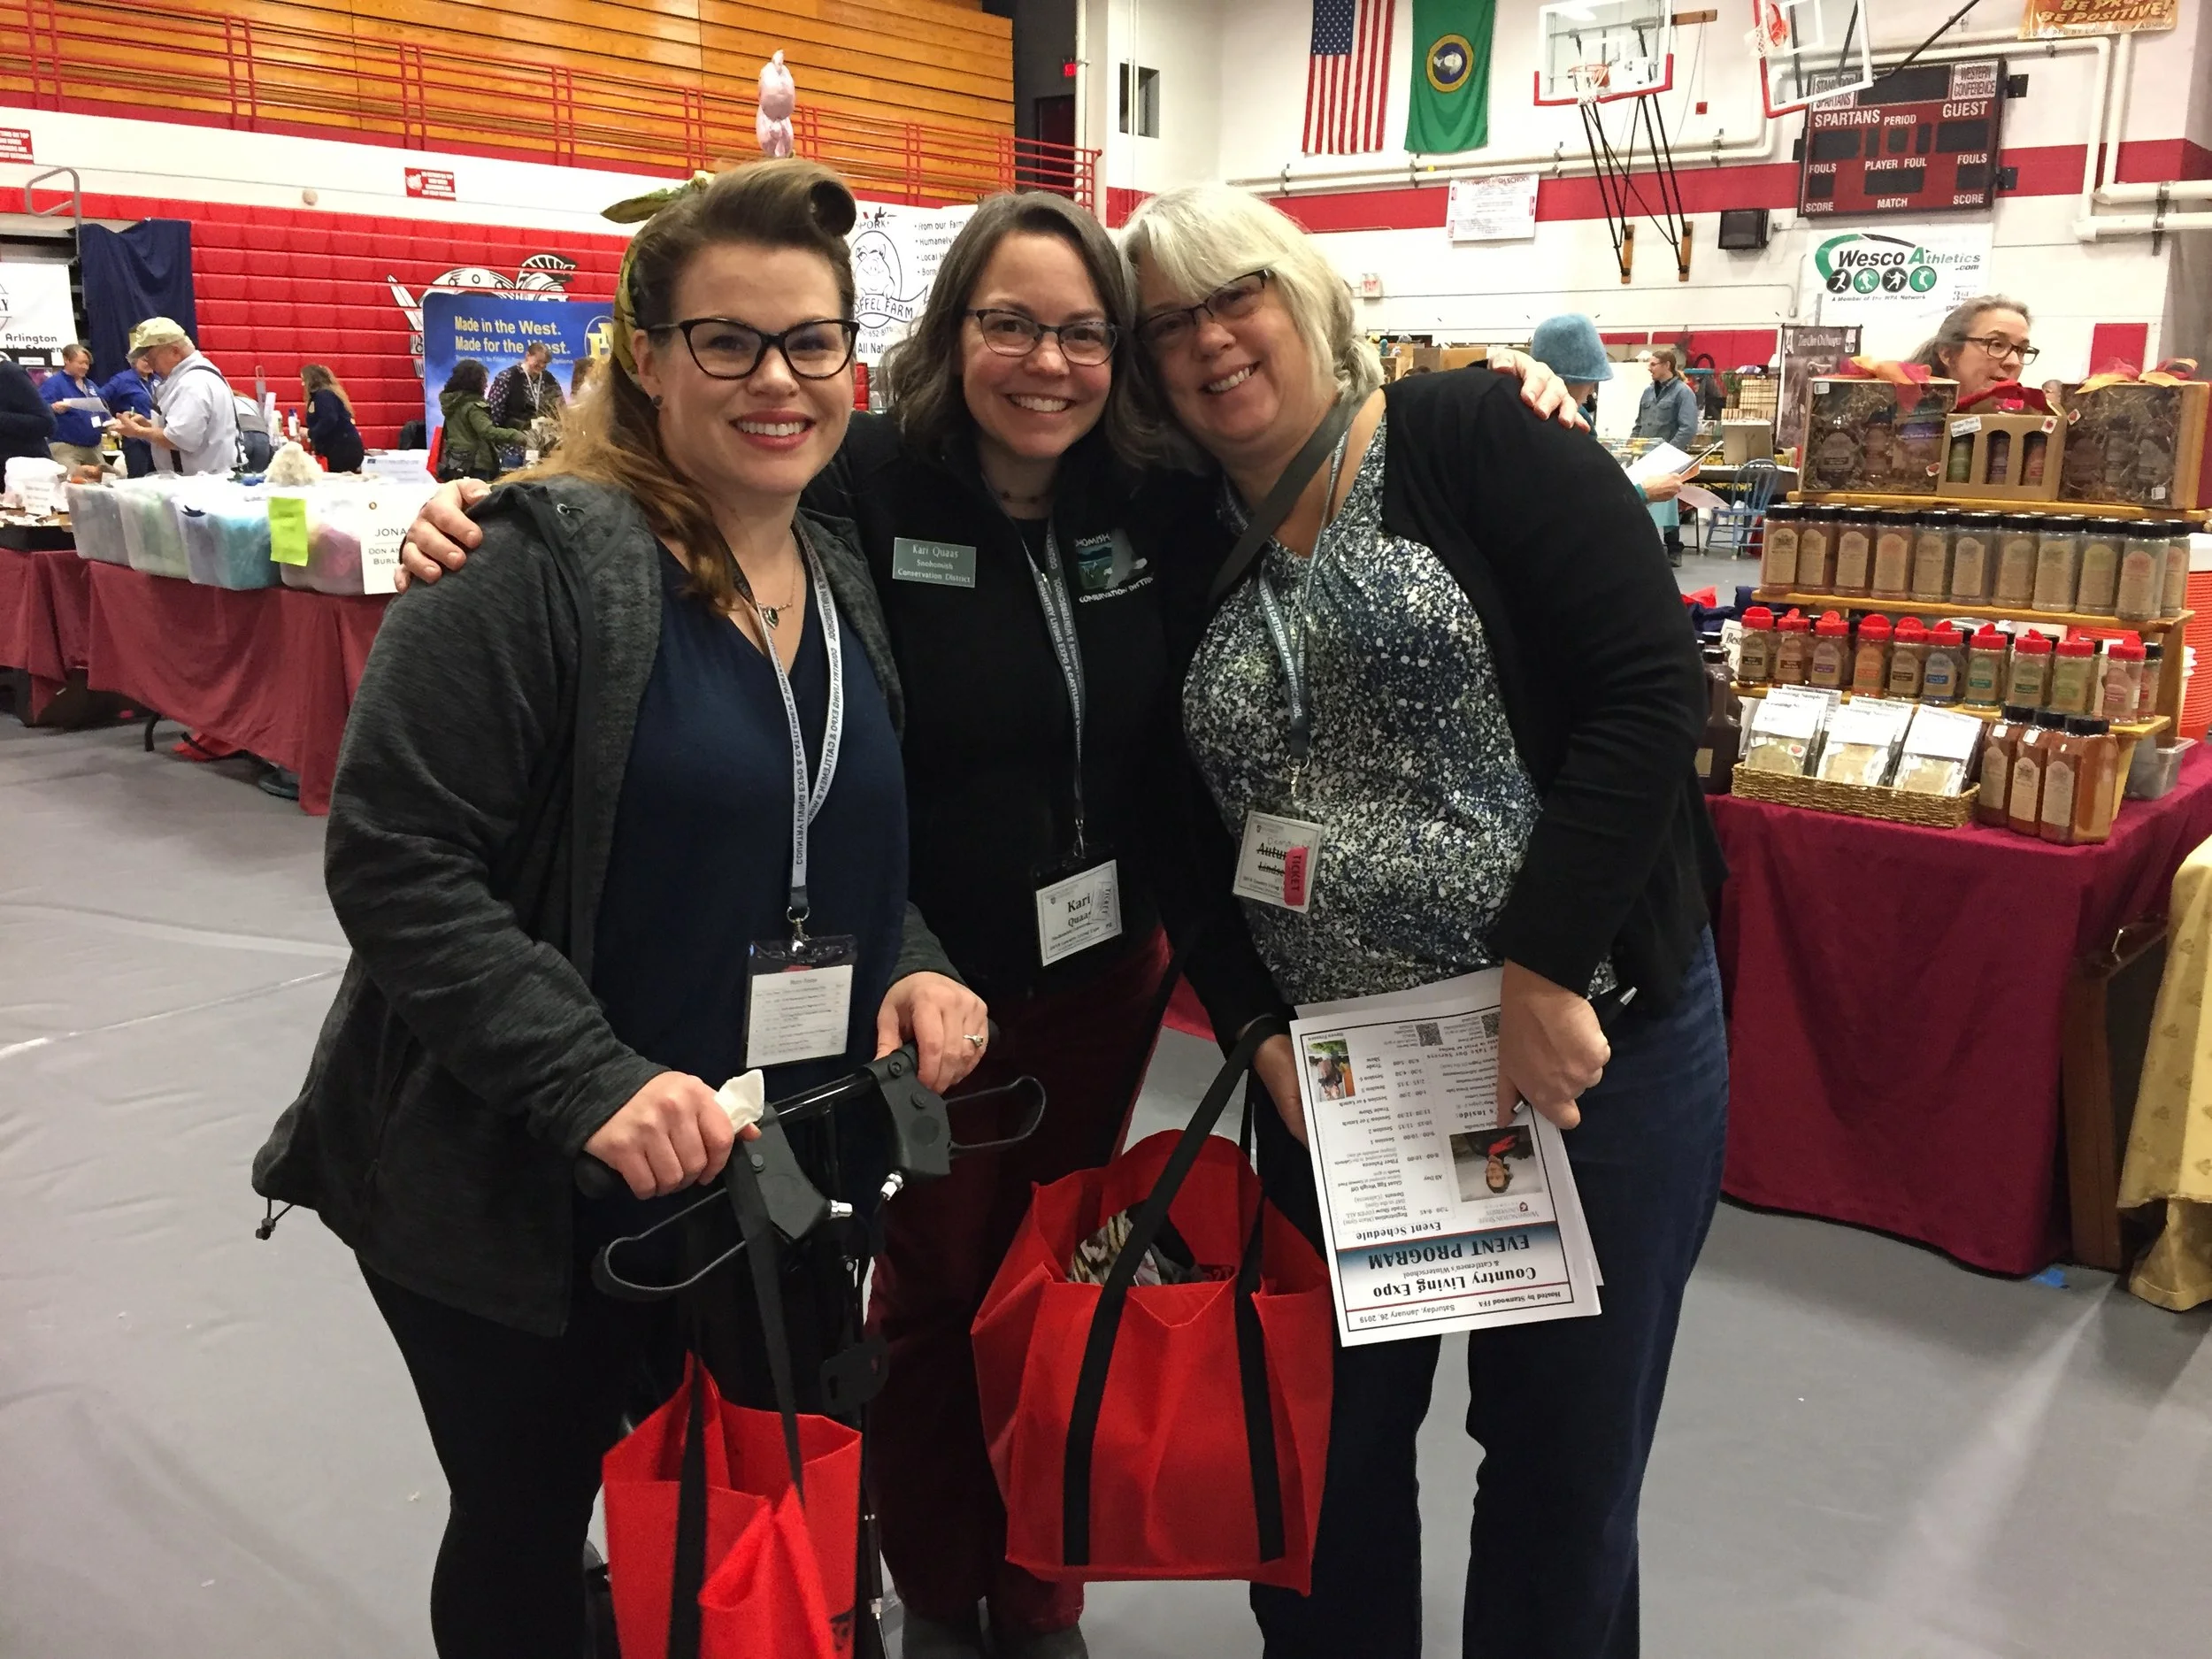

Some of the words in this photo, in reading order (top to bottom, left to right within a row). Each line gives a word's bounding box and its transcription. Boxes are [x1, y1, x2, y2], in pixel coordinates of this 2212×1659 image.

[2038, 12, 2067, 23] BE
[2070, 0, 2173, 22] POSITIVE!
[1943, 101, 1987, 118] GUEST
[1815, 110, 1880, 127] SPARTANS
[1884, 114, 1916, 126] PERIOD
[1865, 159, 1898, 170] PLAYER
[1904, 157, 1927, 168] FOUL
[1957, 154, 1987, 165] FOULS
[1809, 163, 1837, 173] FOULS
[1877, 198, 1908, 209] MATCH
[1954, 193, 1984, 204] SCORE
[1805, 202, 1833, 212] SCORE
[1838, 250, 1905, 267] Wesco
[1908, 246, 1981, 265] Athletics
[885, 301, 913, 319] FARM
[455, 315, 480, 333] Made
[481, 317, 492, 333] in
[495, 319, 516, 334] the
[518, 319, 562, 335] West.
[5, 333, 58, 344] Arlington
[455, 336, 481, 352] Made
[484, 336, 501, 352] for
[503, 338, 525, 353] the
[858, 342, 868, 354] All
[912, 544, 929, 555] Kari
[897, 568, 942, 580] Conservation
[1291, 855, 1302, 892] TICKET
[1067, 893, 1091, 913] Kari
[1355, 1225, 1406, 1241] Schedule
[1409, 1221, 1440, 1233] Event
[1468, 1233, 1530, 1256] EVENT
[1367, 1241, 1462, 1270] PROGRAM
[1402, 1266, 1450, 1279] Winterschool
[1449, 1260, 1493, 1272] Cattlemen's
[1470, 1263, 1537, 1286] Country
[1415, 1272, 1465, 1294] Living
[1371, 1280, 1410, 1300] Expo
[1536, 1290, 1561, 1300] Hosted
[1492, 1294, 1525, 1306] Stanwood
[1526, 1292, 1535, 1302] by
[1389, 1307, 1420, 1319] January
[1420, 1302, 1455, 1315] Saturday,
[1358, 1314, 1376, 1324] 2019
